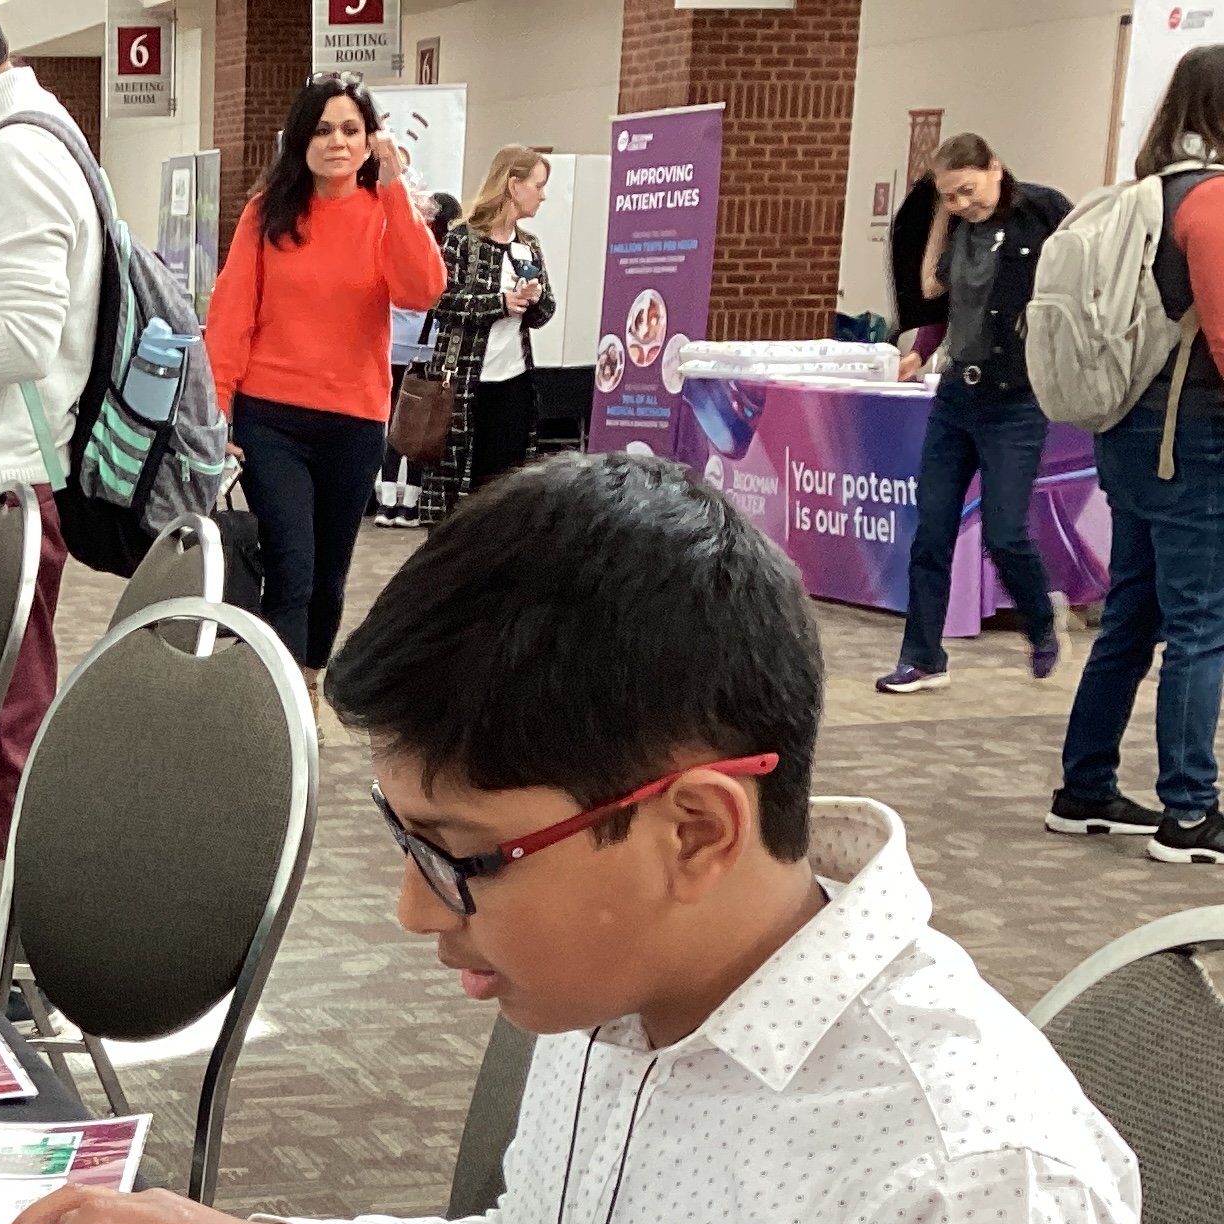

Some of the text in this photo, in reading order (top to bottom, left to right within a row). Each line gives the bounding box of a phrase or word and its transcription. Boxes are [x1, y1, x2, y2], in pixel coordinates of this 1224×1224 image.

[130, 34, 149, 68] 6
[325, 33, 387, 48] MEETING
[336, 49, 375, 62] ROOM
[115, 82, 164, 93] MEETING
[124, 94, 155, 104] ROOM
[626, 164, 693, 186] IMPROVING
[616, 189, 700, 211] PATIENT LIVES
[792, 461, 836, 496] Your
[795, 501, 895, 544] is our fuel
